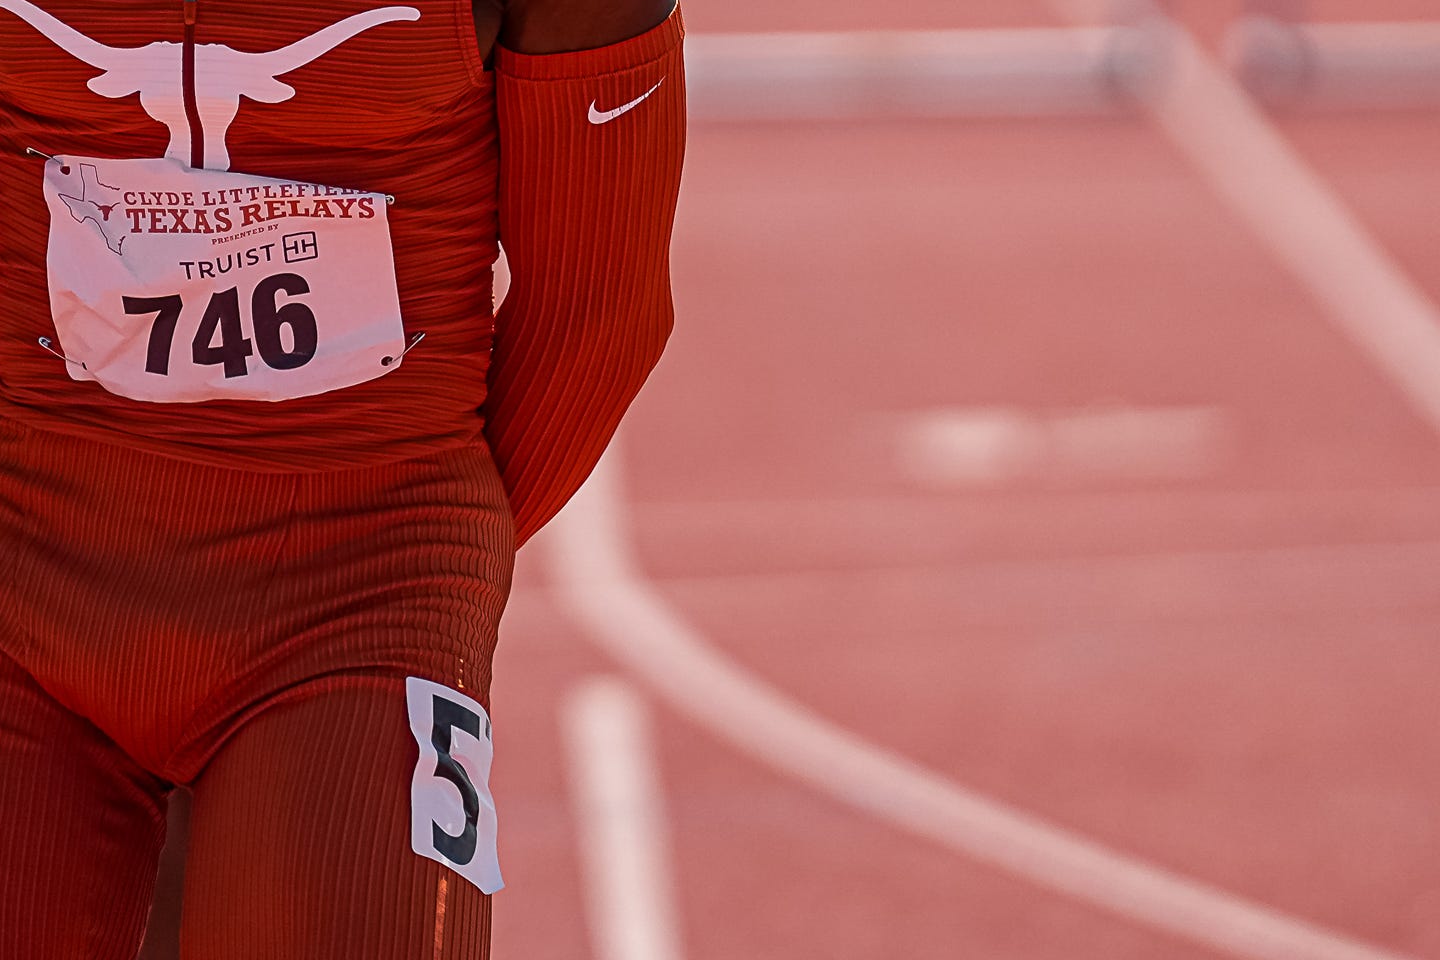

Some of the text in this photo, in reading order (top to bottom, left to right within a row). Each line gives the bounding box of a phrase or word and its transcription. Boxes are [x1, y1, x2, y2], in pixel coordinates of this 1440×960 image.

[123, 191, 194, 206] CLYDE
[125, 197, 375, 233] TEXAS RELAYS
[212, 223, 279, 245] PRESENTED BY
[179, 243, 275, 280] TRUIST
[121, 272, 318, 379] 746
[431, 694, 480, 865] 5
